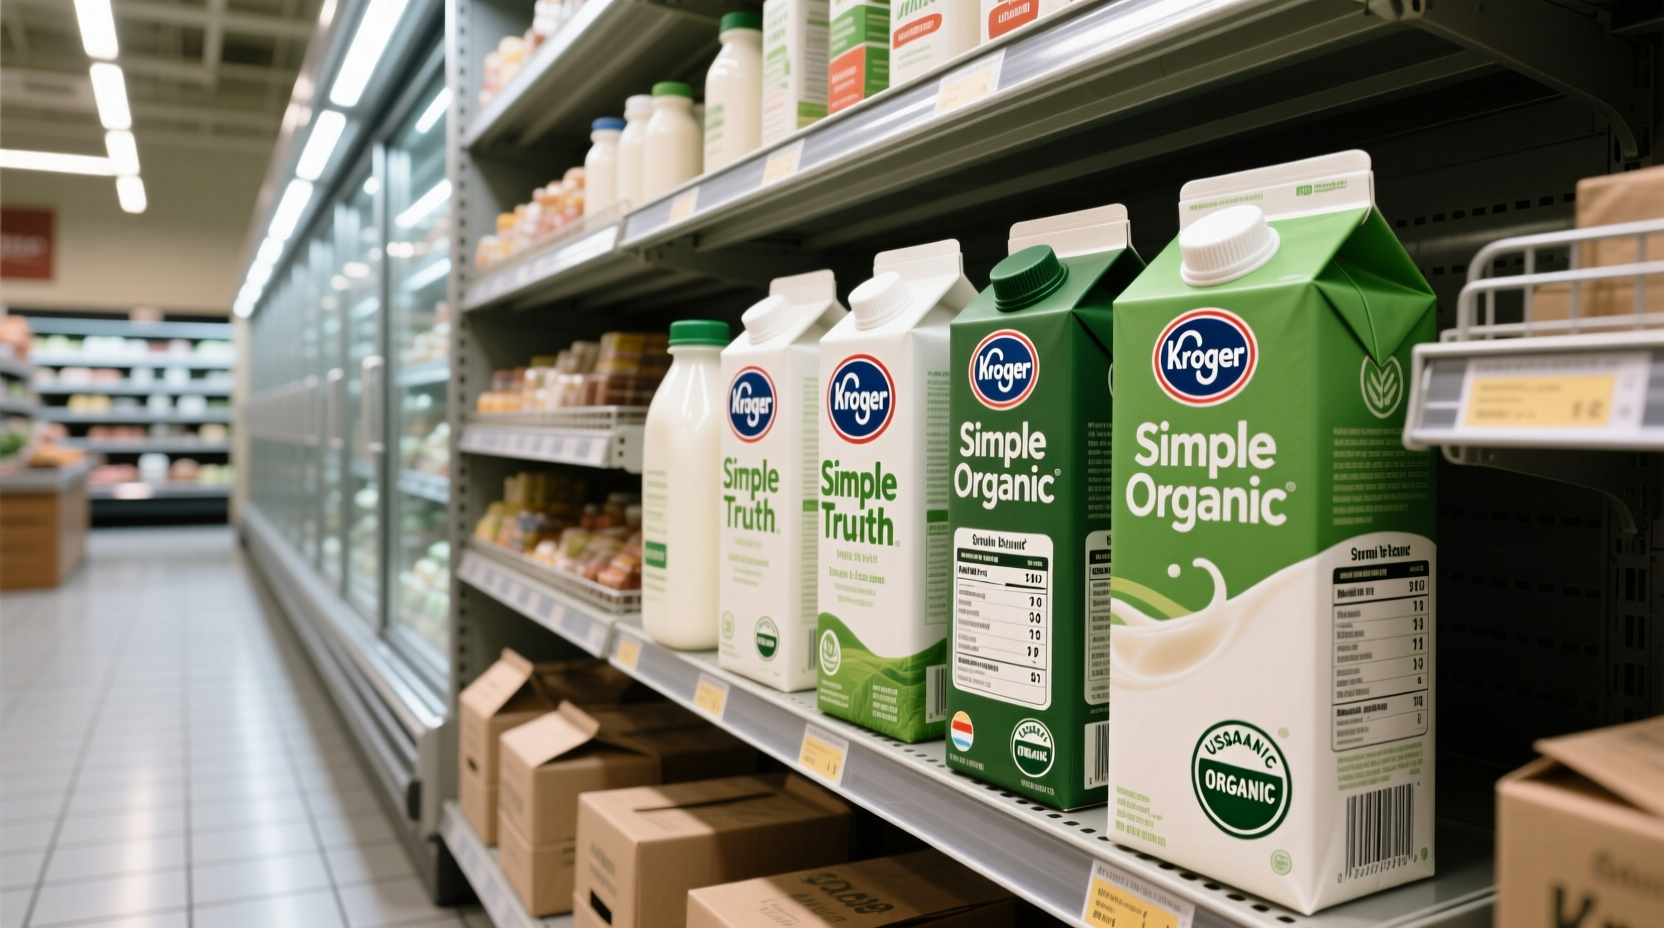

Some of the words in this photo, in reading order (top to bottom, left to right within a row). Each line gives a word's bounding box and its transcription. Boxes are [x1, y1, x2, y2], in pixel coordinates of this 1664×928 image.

[978, 347, 1031, 393] Kroger
[1167, 329, 1245, 386] Kroger
[732, 381, 772, 428] Kroger
[834, 372, 888, 426] Kroger
[960, 421, 1047, 468] Simple
[1134, 420, 1277, 479] Simple
[723, 456, 780, 501] Simple
[821, 459, 898, 510] Simple
[954, 462, 1056, 510] Organic
[723, 495, 776, 534] Truth
[1125, 472, 1287, 533] Organic
[1205, 768, 1276, 805] ORGANIC
